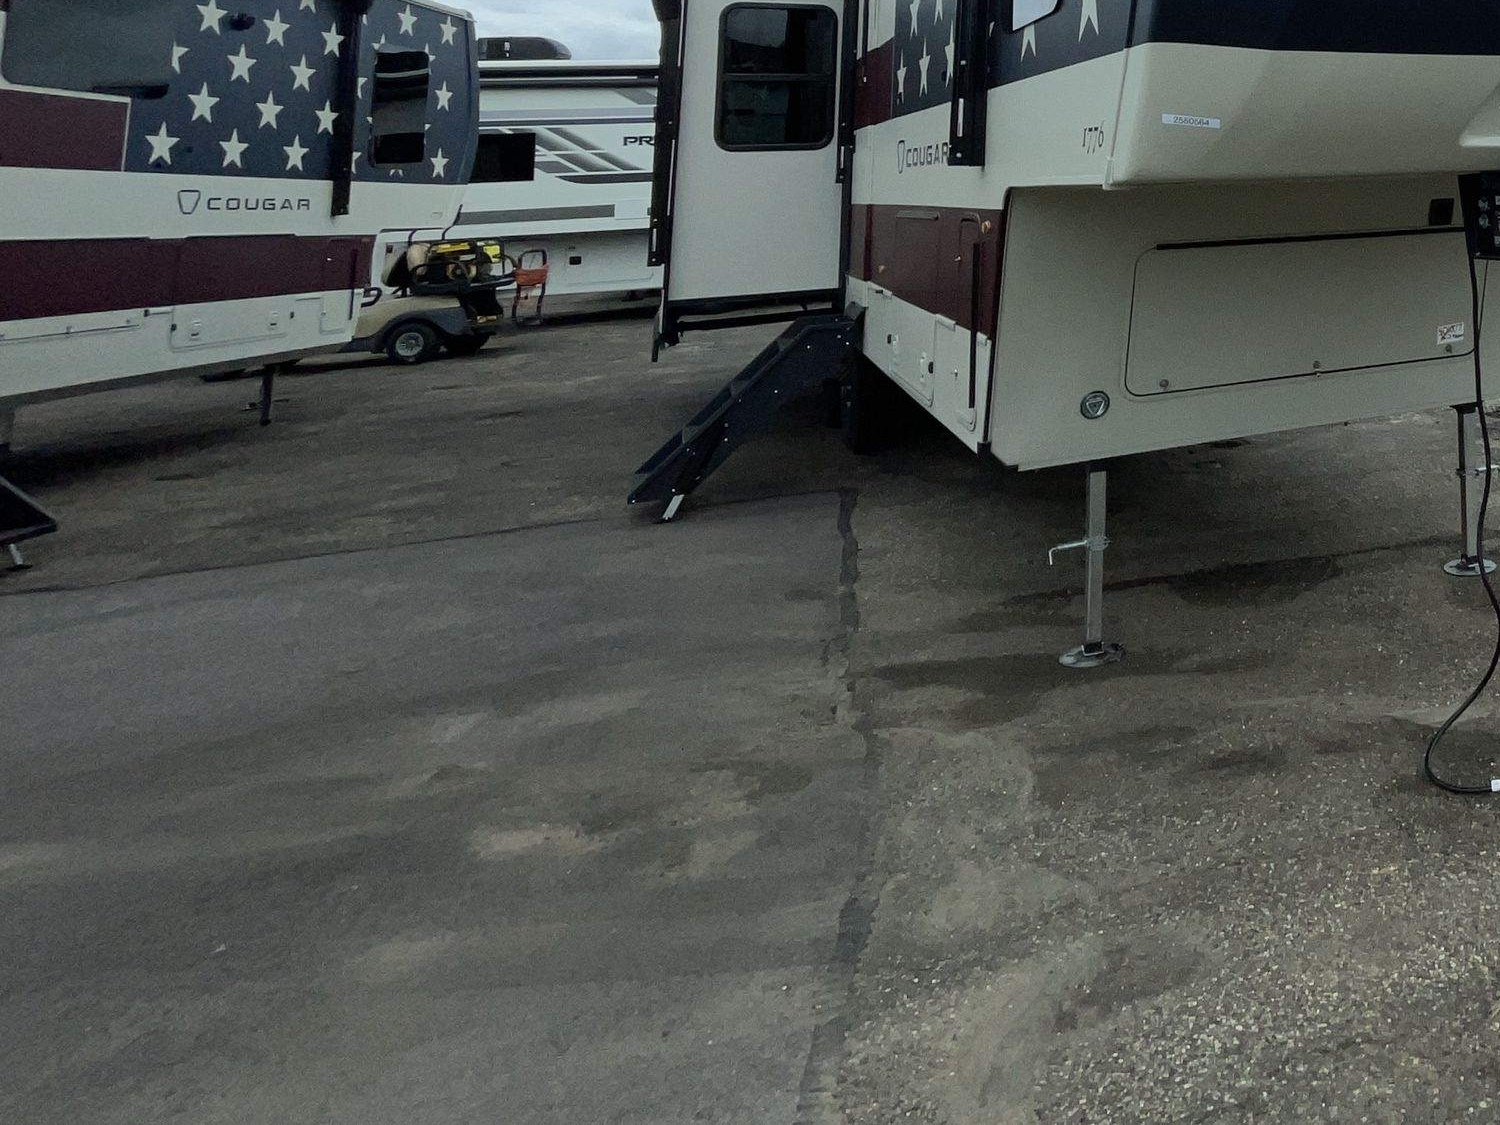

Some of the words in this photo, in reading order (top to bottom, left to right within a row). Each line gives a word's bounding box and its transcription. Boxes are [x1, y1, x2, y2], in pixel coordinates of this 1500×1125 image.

[1082, 120, 1105, 154] 1776
[905, 141, 949, 168] COUGAR
[207, 197, 311, 211] COUGAR
